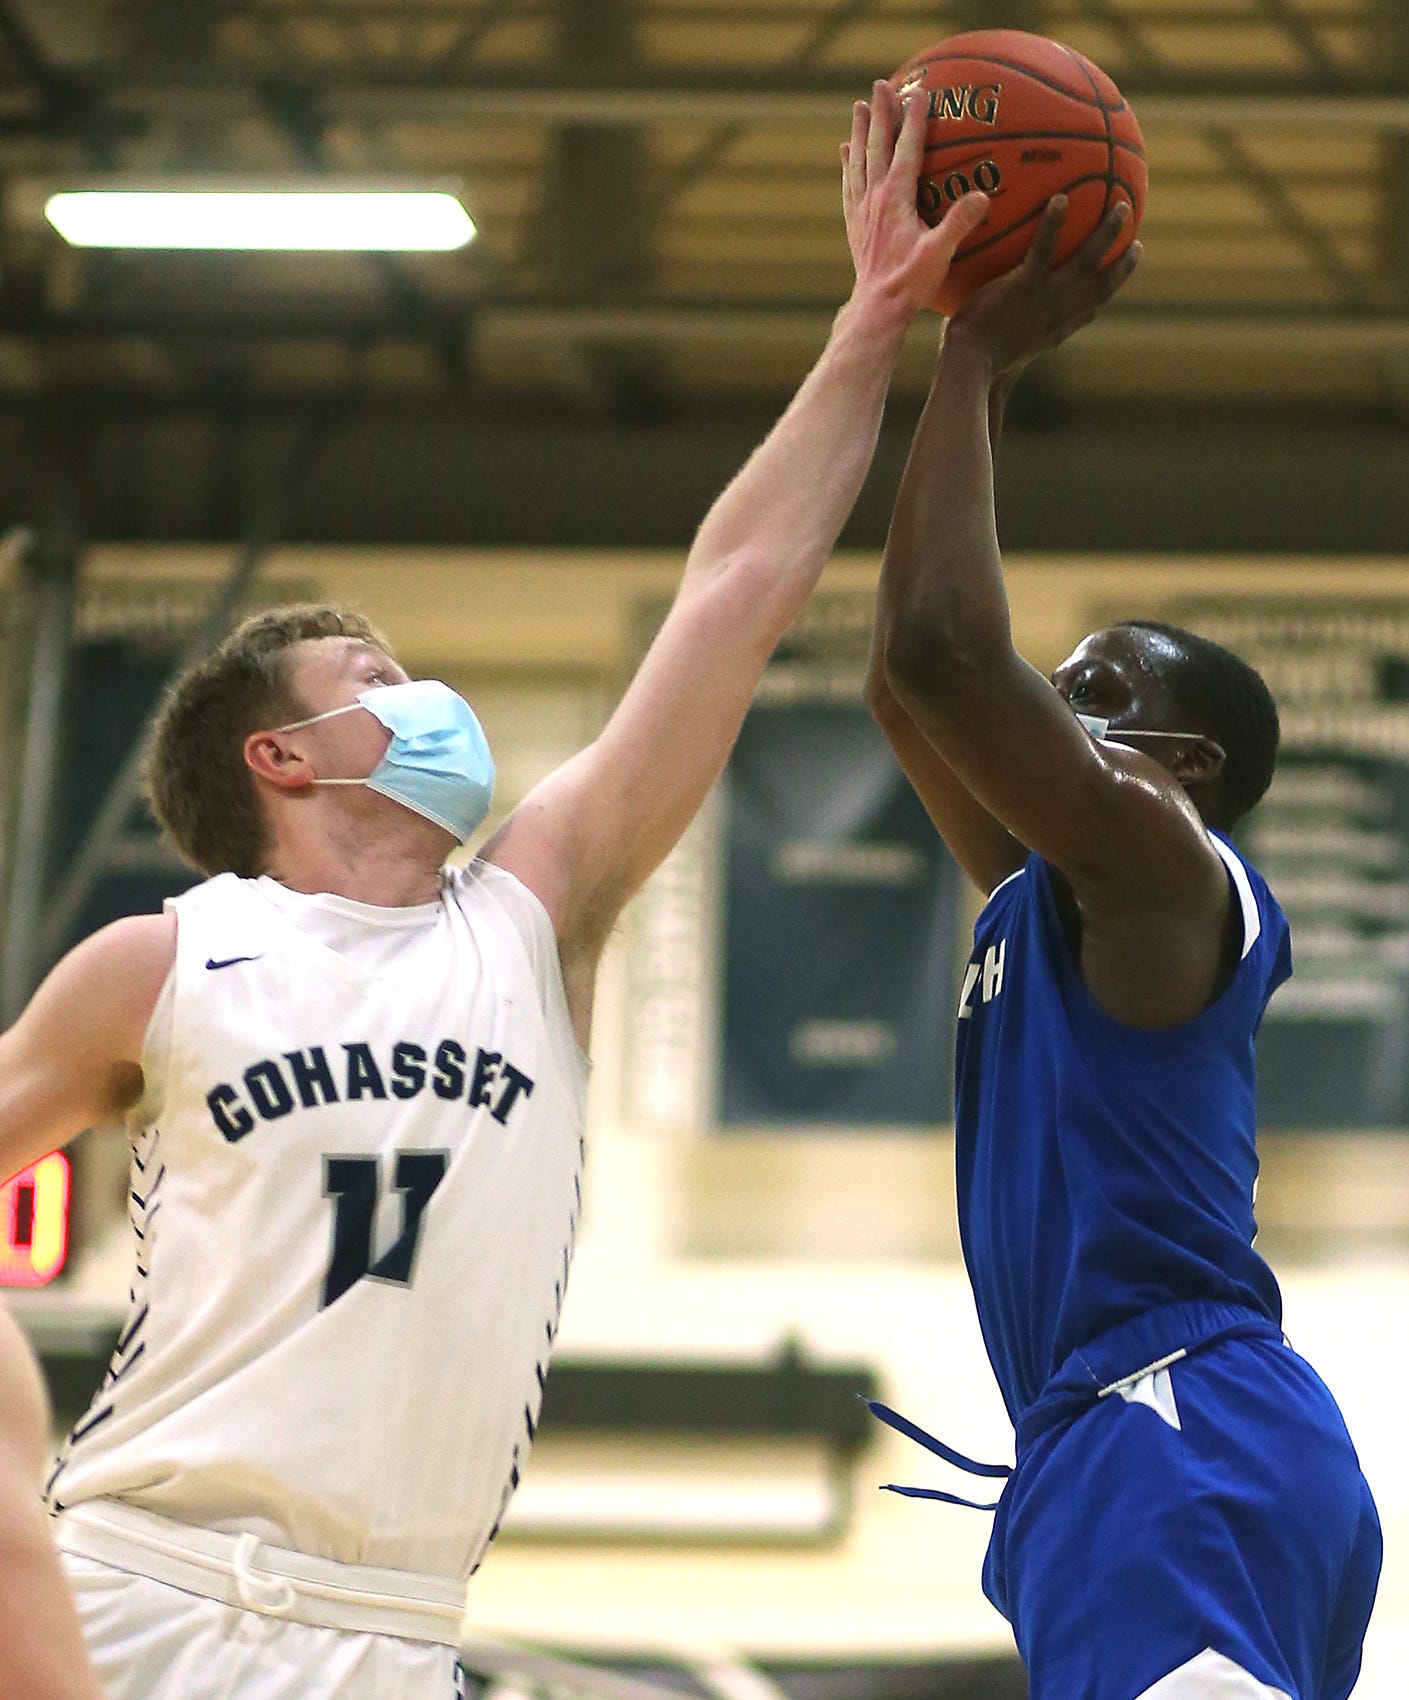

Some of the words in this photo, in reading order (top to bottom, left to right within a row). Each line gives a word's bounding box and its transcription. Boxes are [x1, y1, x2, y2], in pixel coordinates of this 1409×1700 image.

[927, 83, 1002, 125] ING
[917, 160, 1002, 211] 000
[206, 1038, 535, 1144] COHASSET
[319, 1148, 450, 1313] 11
